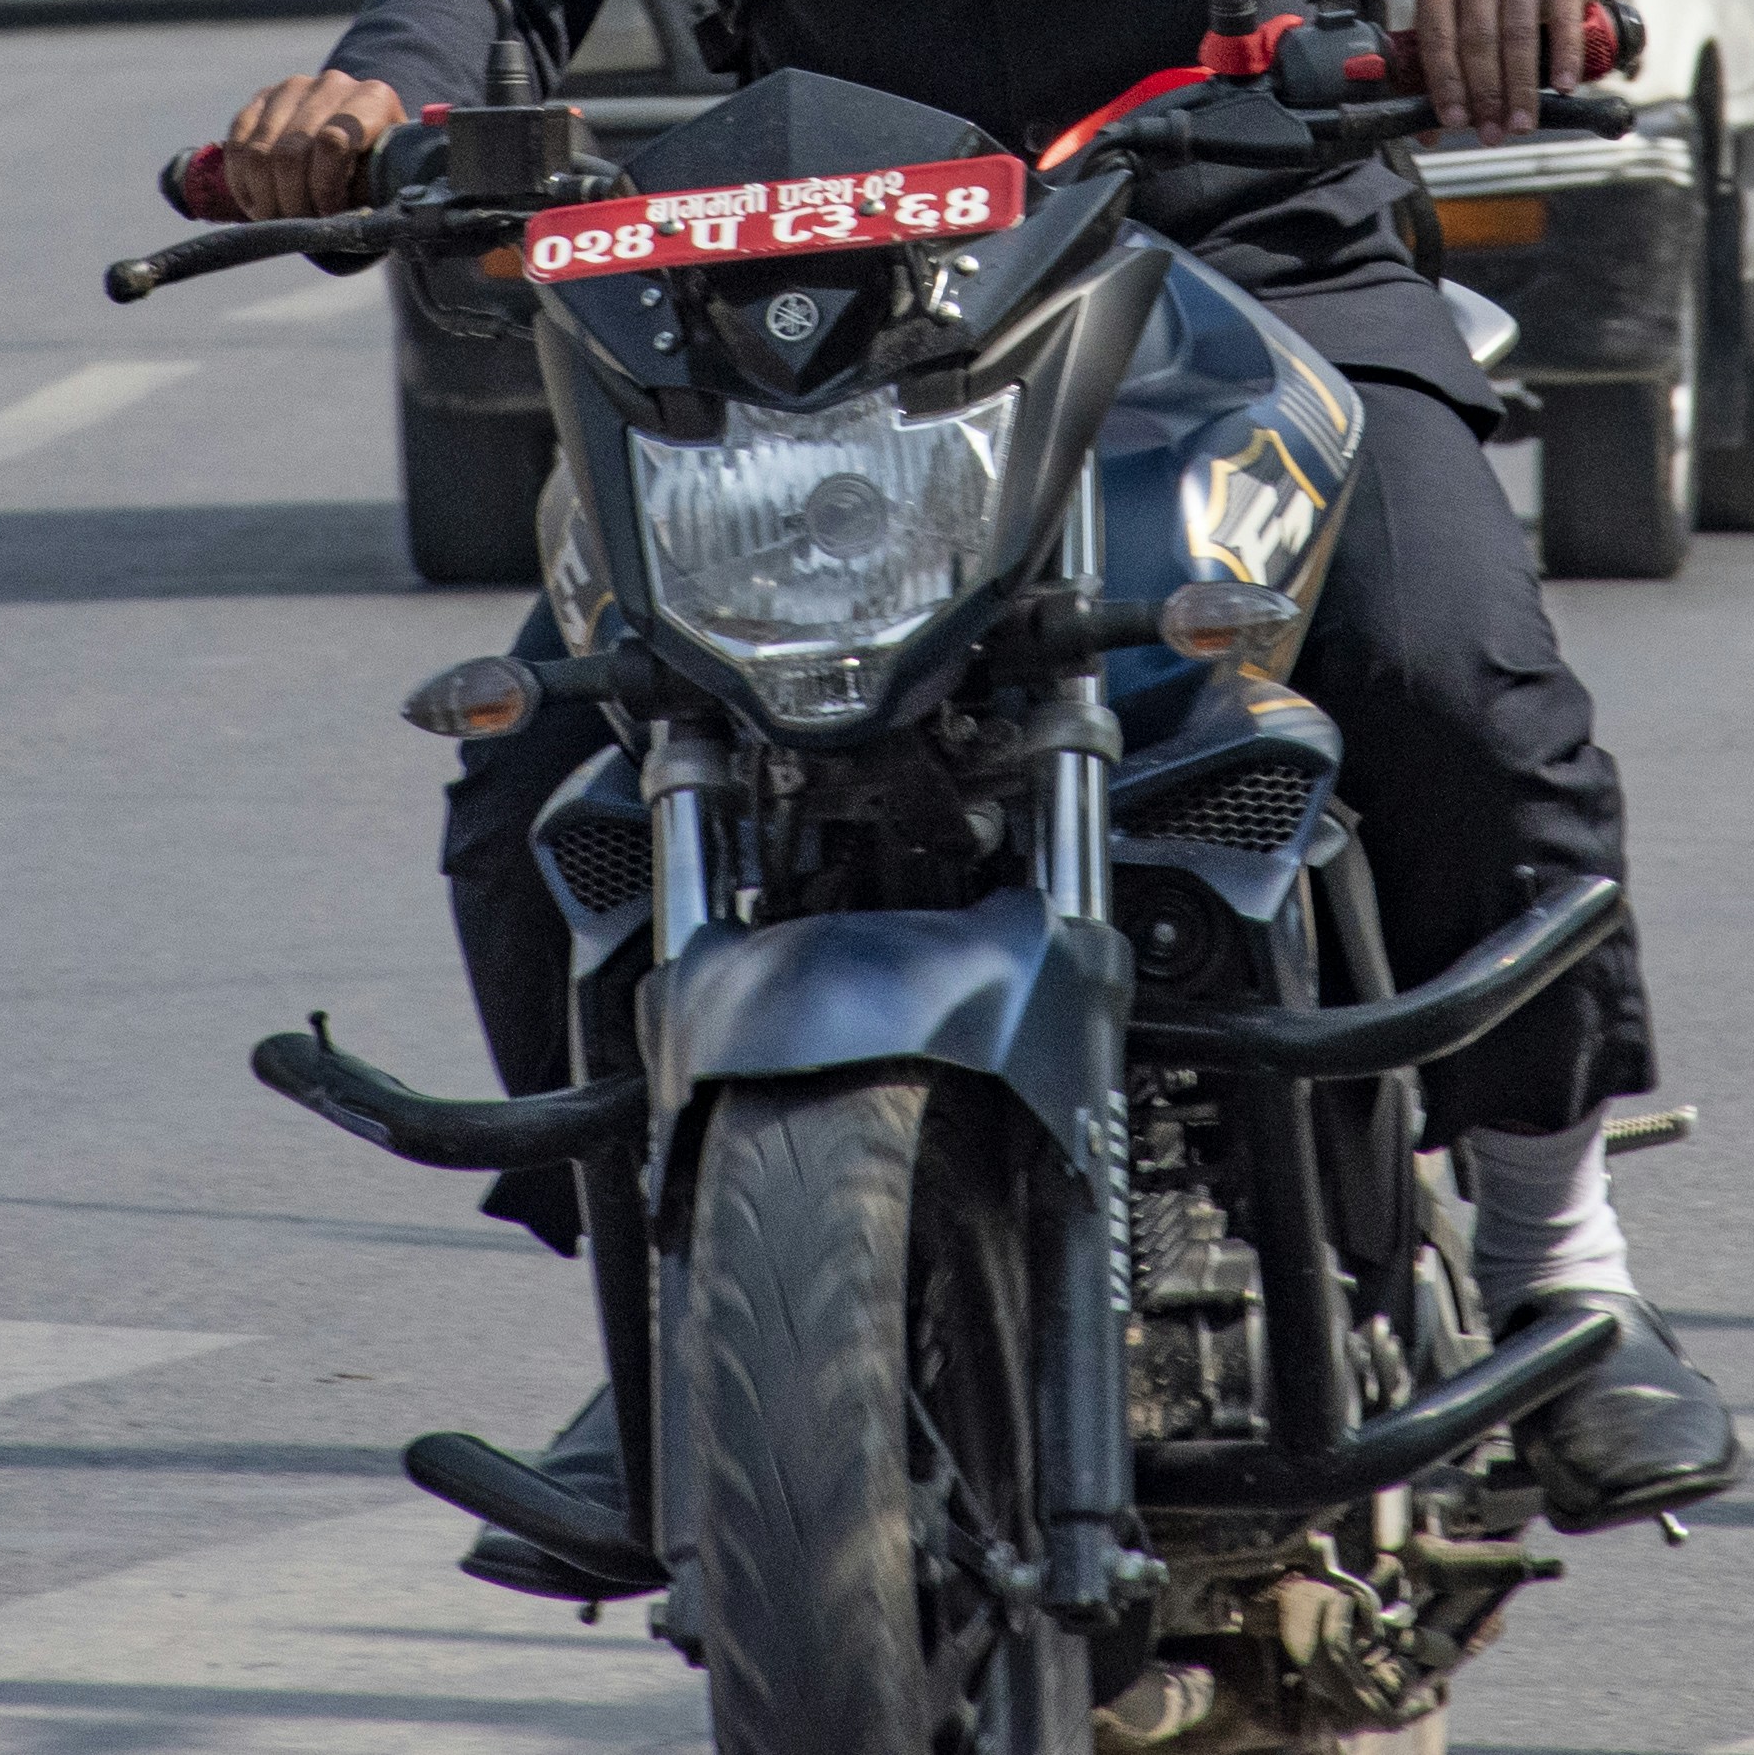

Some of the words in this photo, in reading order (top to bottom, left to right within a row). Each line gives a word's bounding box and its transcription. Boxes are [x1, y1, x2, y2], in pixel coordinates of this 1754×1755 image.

[532, 222, 655, 271] ०२४
[688, 215, 746, 250] प
[768, 203, 859, 244] ८३
[893, 185, 991, 228] ६४
[645, 182, 770, 223] बागमती
